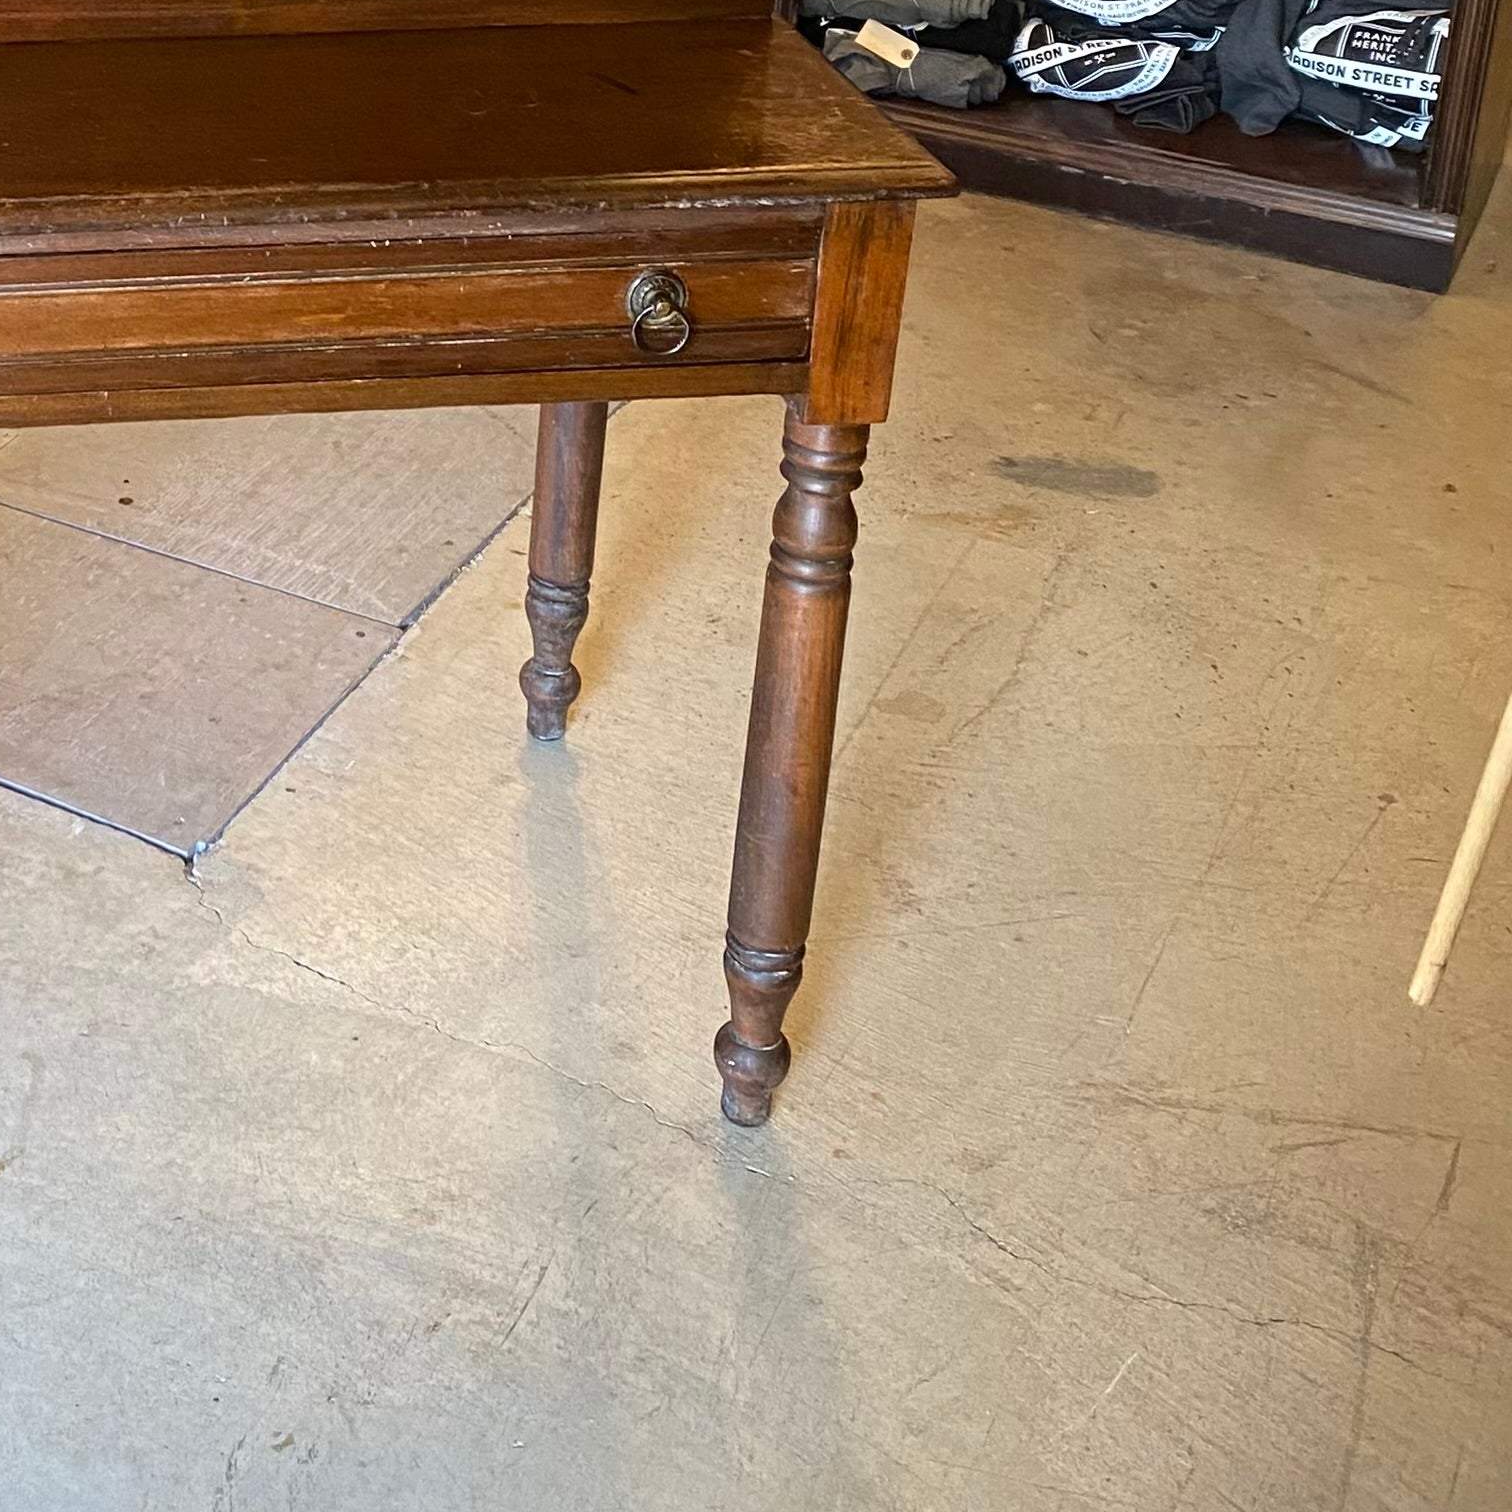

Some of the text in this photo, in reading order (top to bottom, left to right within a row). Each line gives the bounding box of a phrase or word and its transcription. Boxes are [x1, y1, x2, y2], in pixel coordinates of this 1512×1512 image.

[1014, 39, 1124, 73] ADISON STREET
[1351, 67, 1414, 90] STREET
